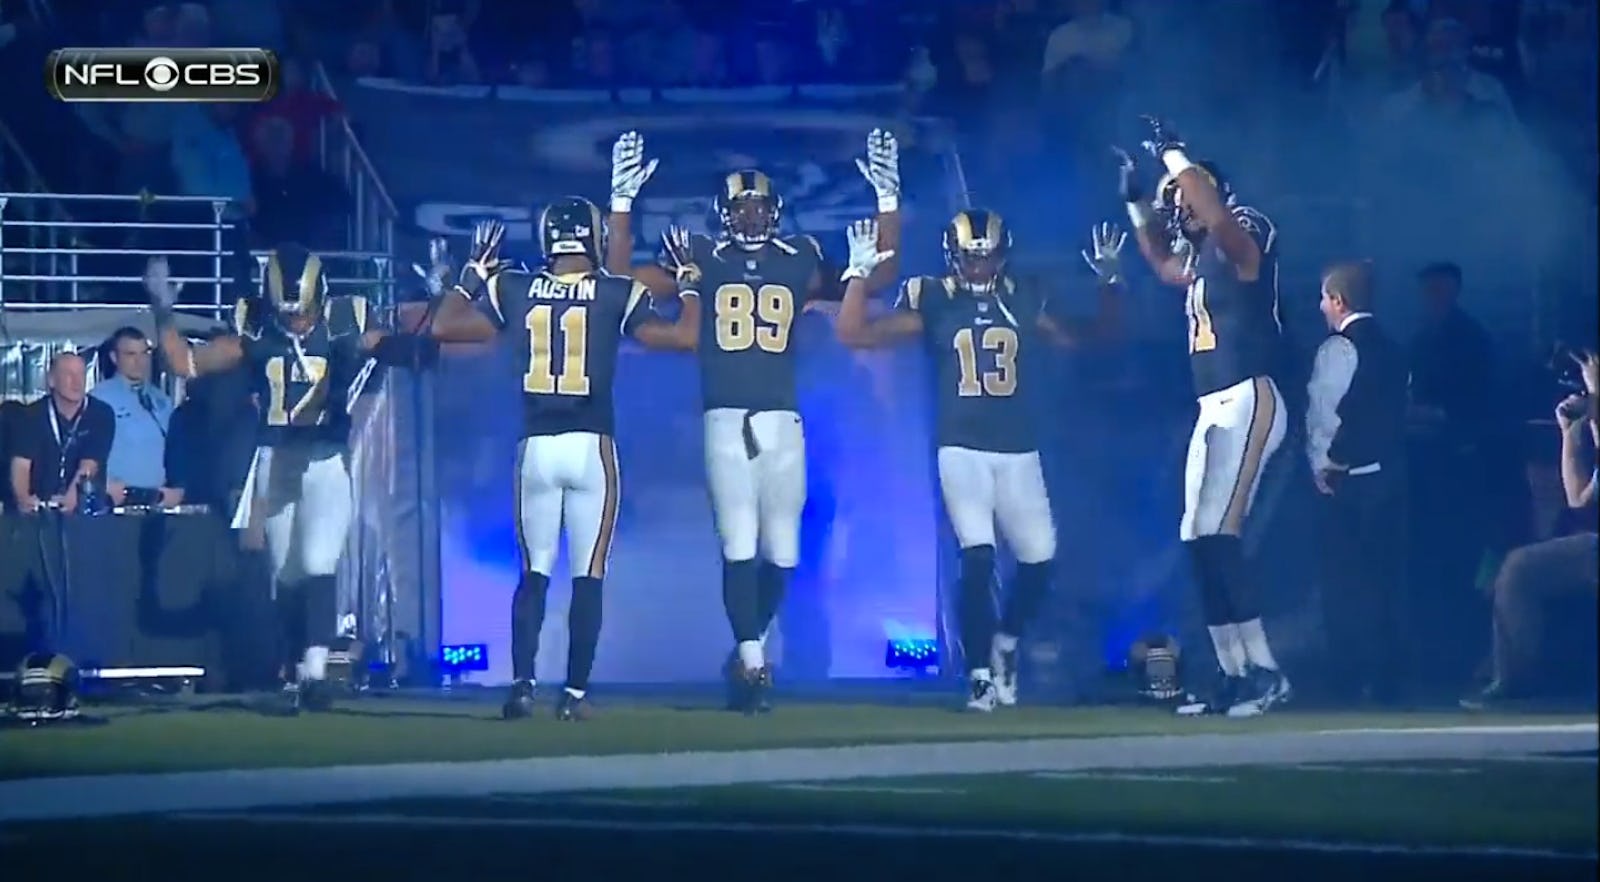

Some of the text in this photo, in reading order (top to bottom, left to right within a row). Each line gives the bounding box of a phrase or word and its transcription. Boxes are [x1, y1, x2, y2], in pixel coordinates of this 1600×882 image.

[528, 278, 596, 300] AUSTIN
[715, 283, 794, 353] 89
[523, 304, 590, 395] 11
[953, 327, 1019, 396] 13
